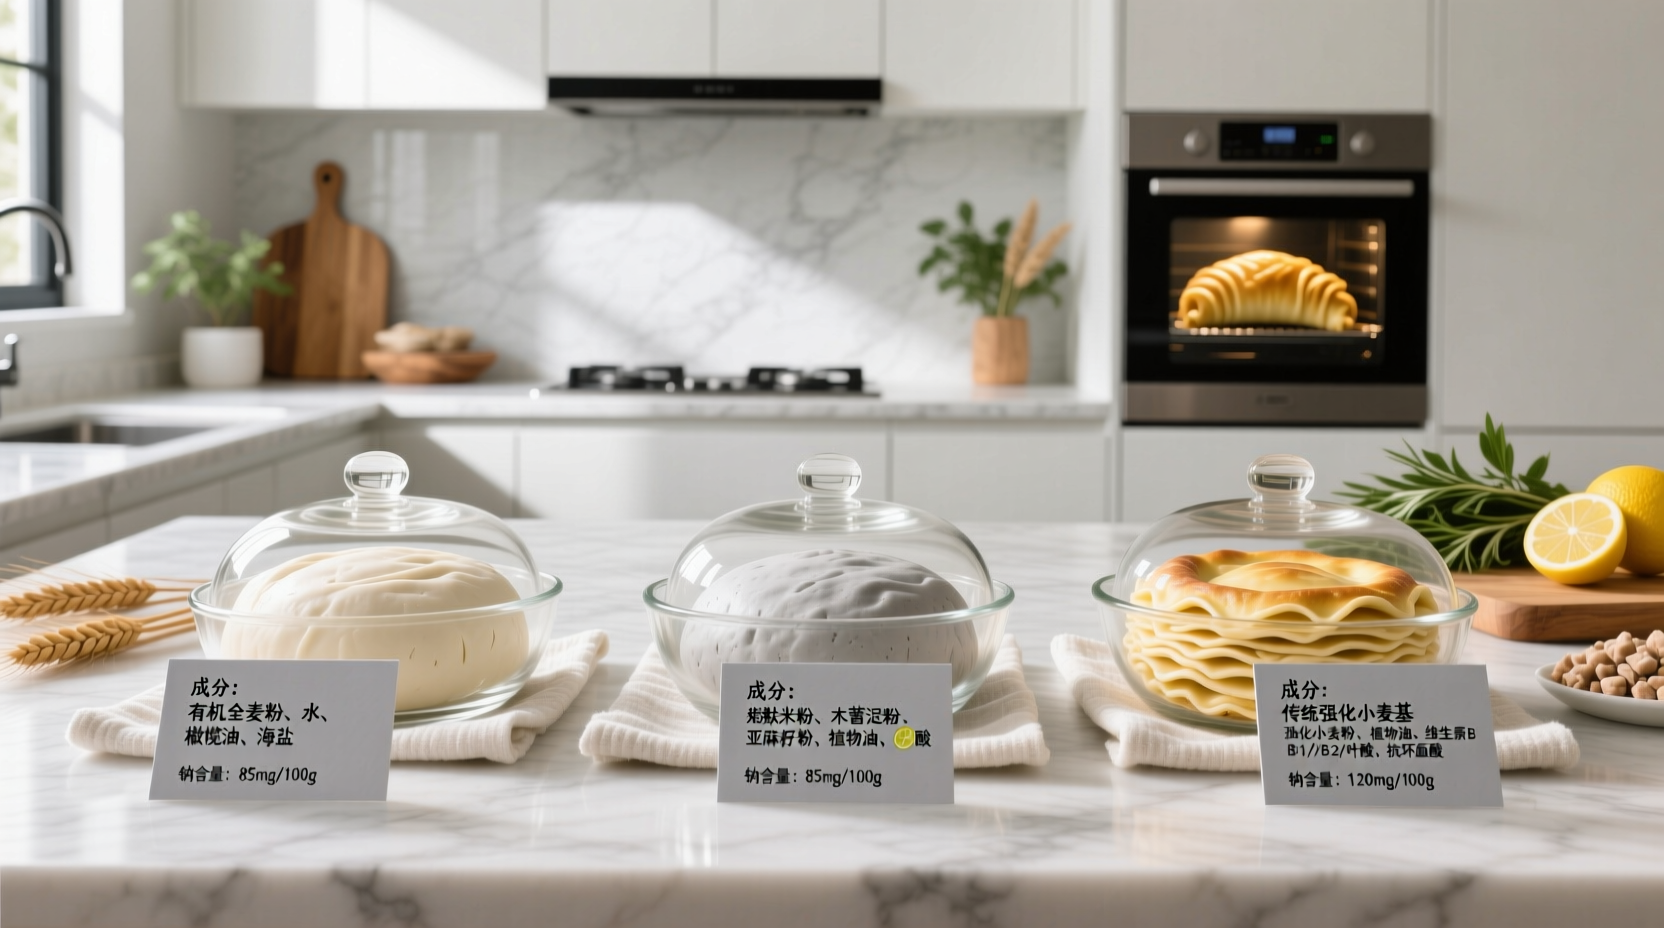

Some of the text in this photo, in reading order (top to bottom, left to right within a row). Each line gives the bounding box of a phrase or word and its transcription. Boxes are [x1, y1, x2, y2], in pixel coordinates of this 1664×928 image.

[190, 676, 238, 698] 成分：
[747, 680, 795, 702] 成分：
[1281, 678, 1328, 701] 成分：
[187, 701, 328, 723] 有机全麦粉、水、
[1281, 701, 1415, 724] 传统强化小麦基
